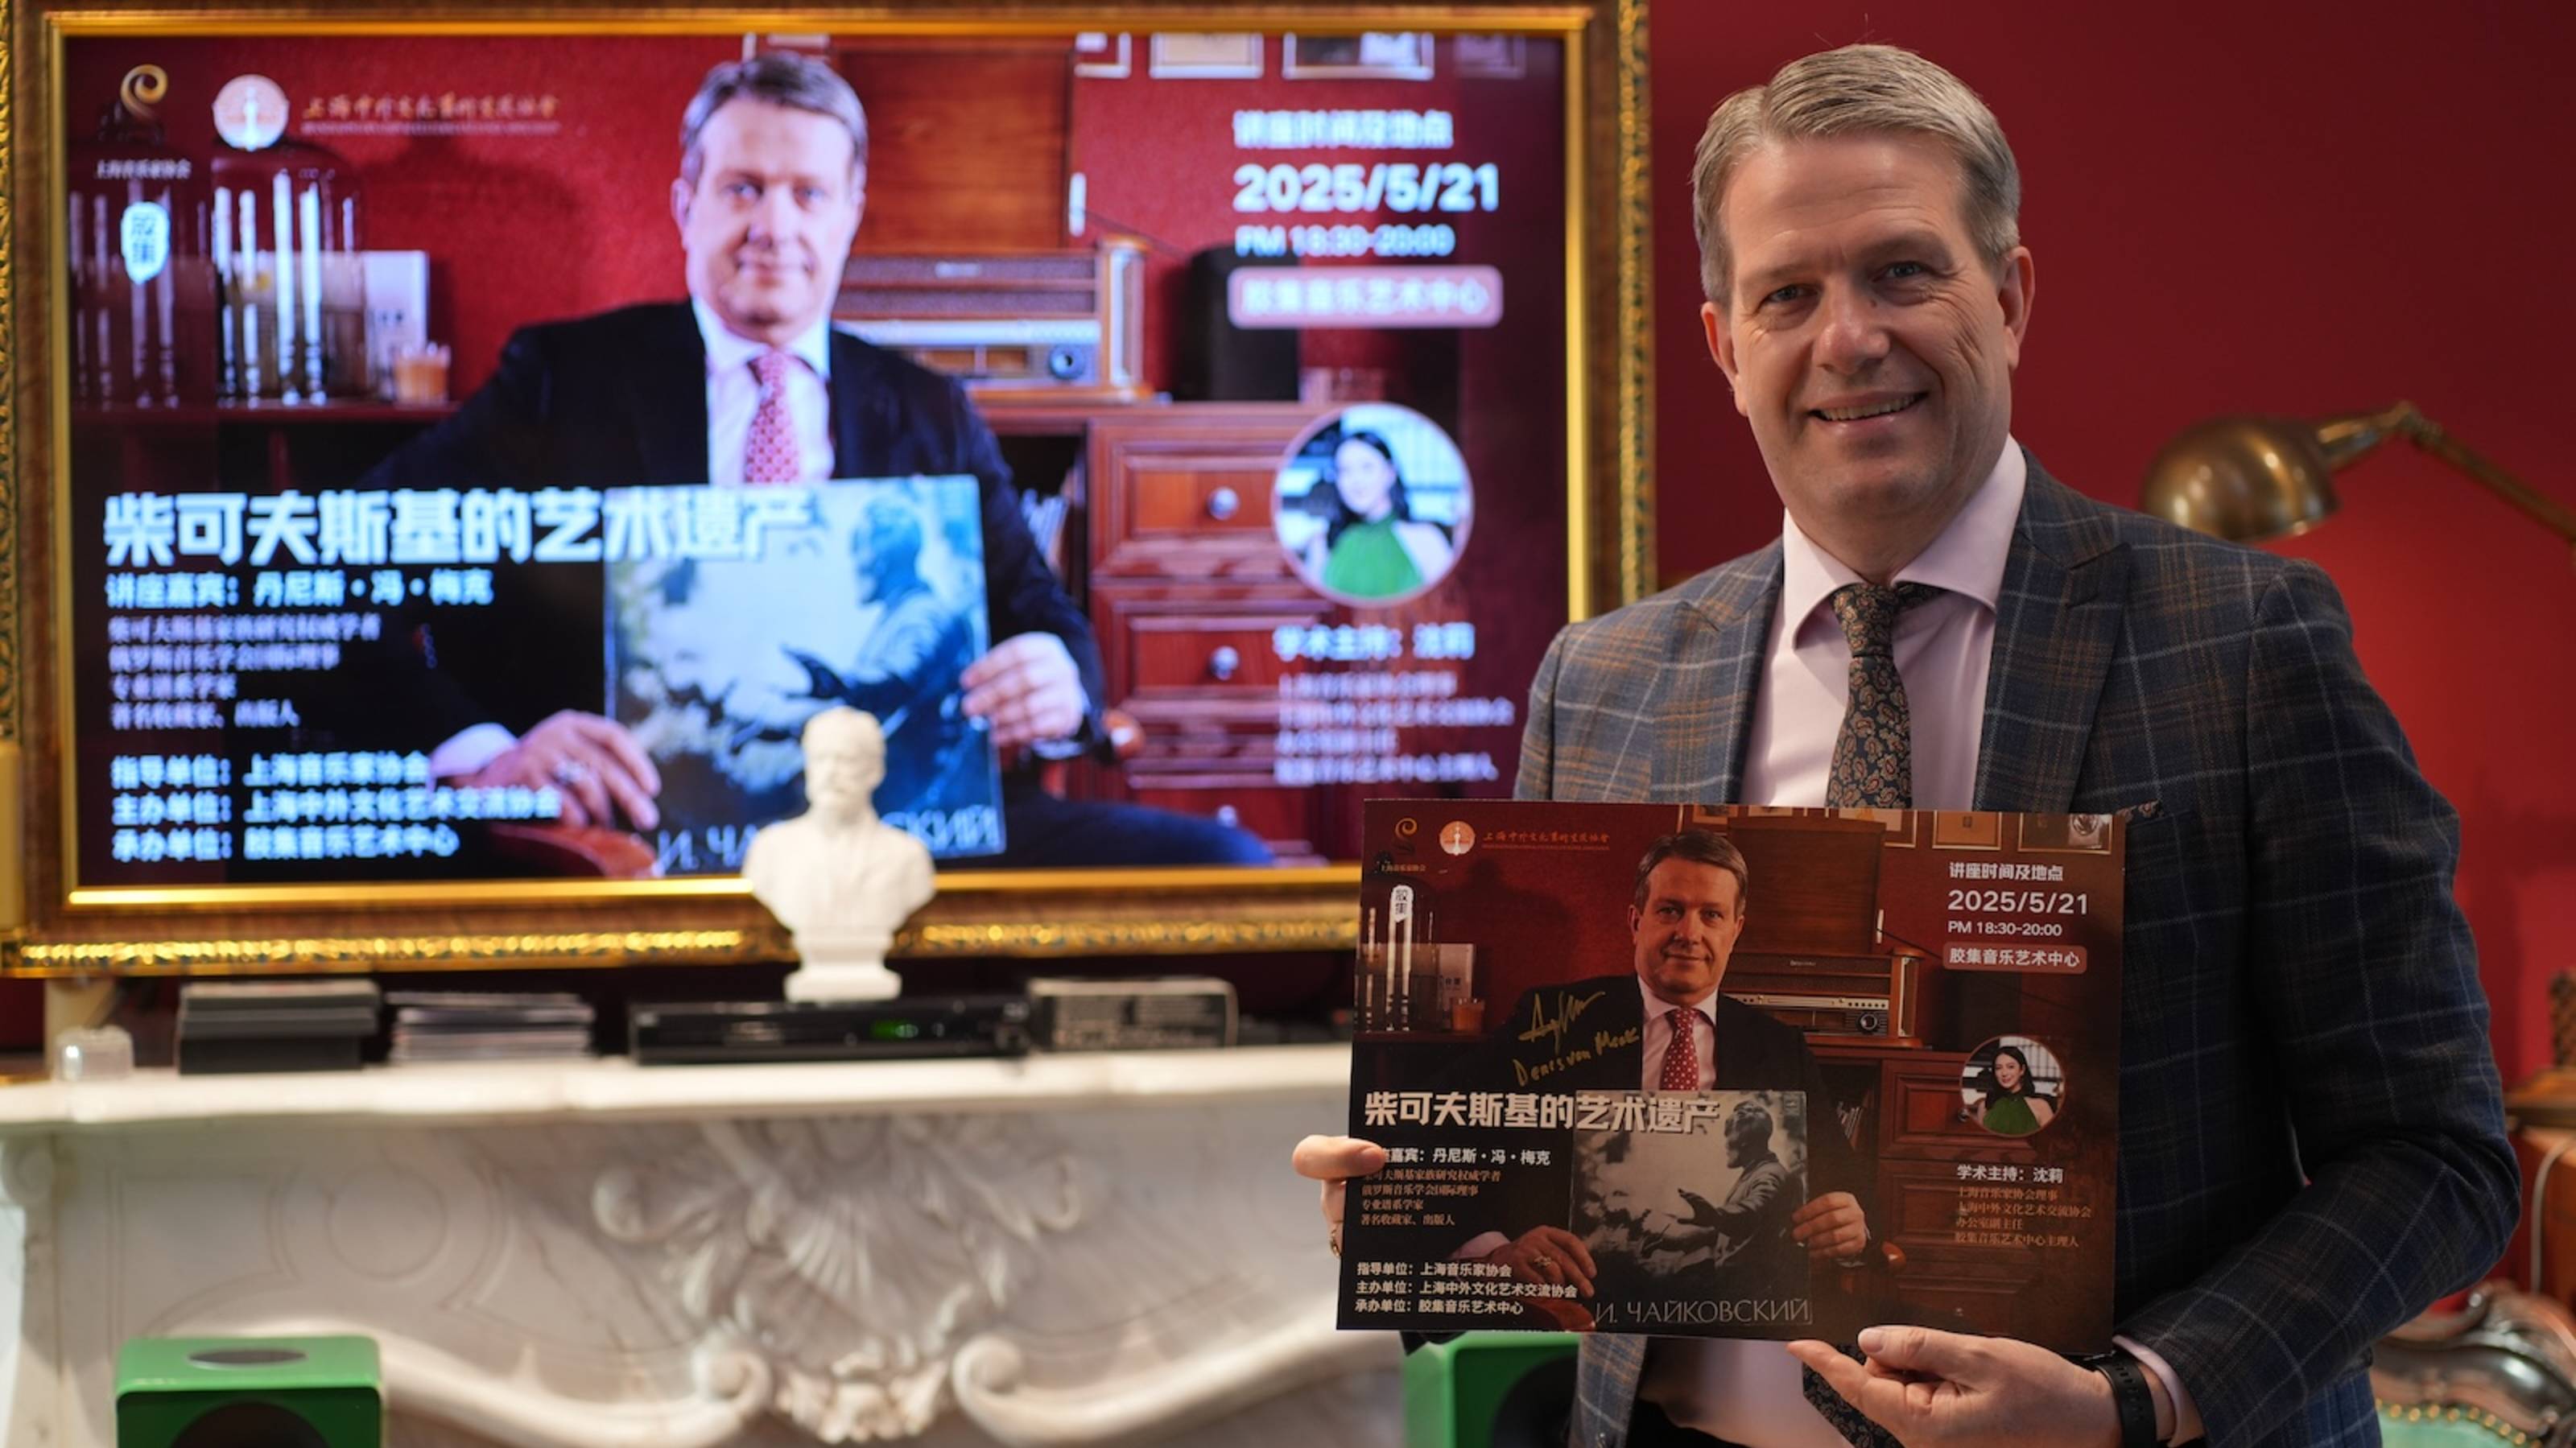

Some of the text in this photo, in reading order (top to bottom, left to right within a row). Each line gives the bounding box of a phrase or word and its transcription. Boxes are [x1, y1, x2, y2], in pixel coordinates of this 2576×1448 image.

[1232, 163, 1500, 212] 2025/5/21
[1235, 225, 1286, 258] PM
[104, 486, 812, 567] 柴可夫斯基的艺术遗产
[1949, 862, 2063, 881] 讲座时间及地点
[1948, 889, 2088, 915] 2025/5/21
[1947, 921, 2062, 936] PM 18:30-20:00
[1949, 947, 2080, 968] 胶集音乐艺术中心
[1364, 1091, 1720, 1134] 柴可夫斯基的艺术遗产
[1384, 1147, 1551, 1166] 嘉宾：丹尼斯·冯·梅克
[1356, 1261, 1513, 1278] 指导单位：上海音乐家协会
[1356, 1280, 1578, 1298] 主办单位：上海中外文化艺术交流协会
[1355, 1298, 1524, 1315] 承办单位：胶集音乐艺术中心
[1627, 1298, 1810, 1324] ЧАЙКОВСКИЙ
